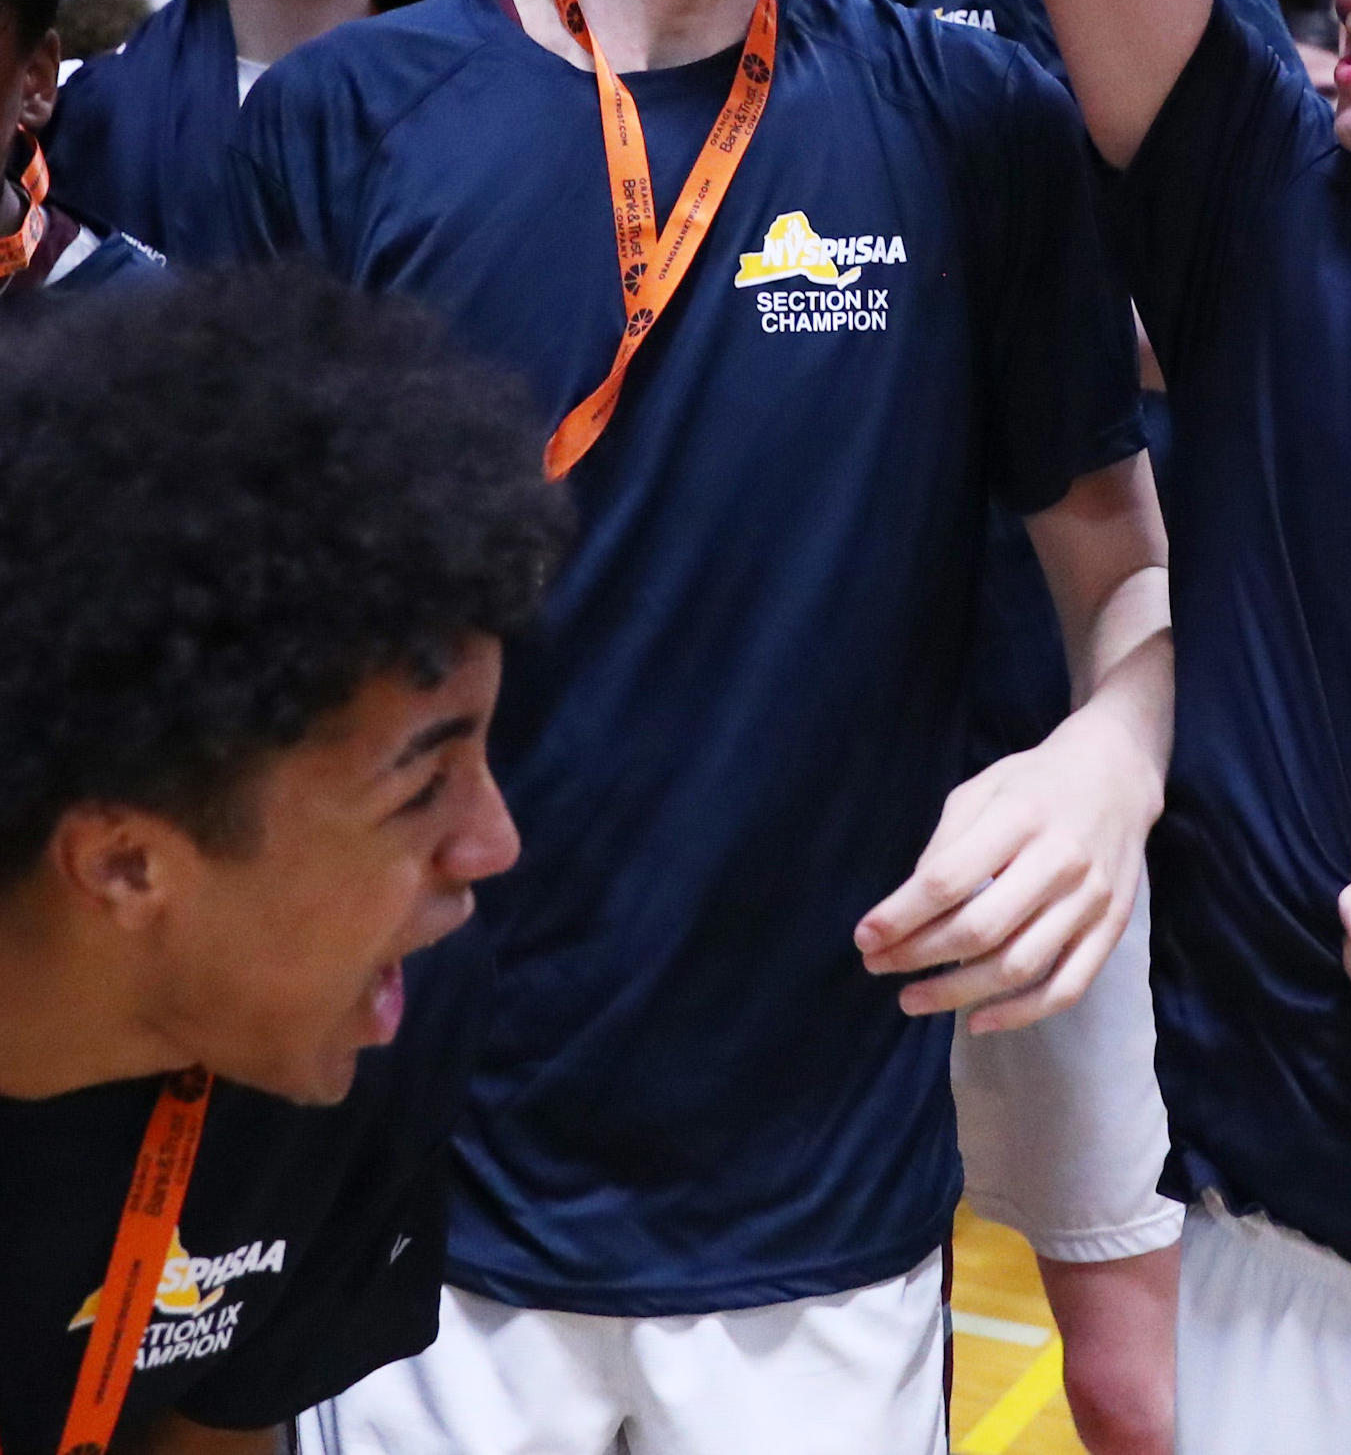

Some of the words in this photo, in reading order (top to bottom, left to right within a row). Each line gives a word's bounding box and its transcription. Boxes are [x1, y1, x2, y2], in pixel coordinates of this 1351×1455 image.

[761, 234, 907, 267] NYSPHSAA
[756, 290, 861, 313] SECTION
[867, 289, 889, 309] IX
[761, 311, 887, 333] CHAMPION
[217, 1300, 245, 1327] IX
